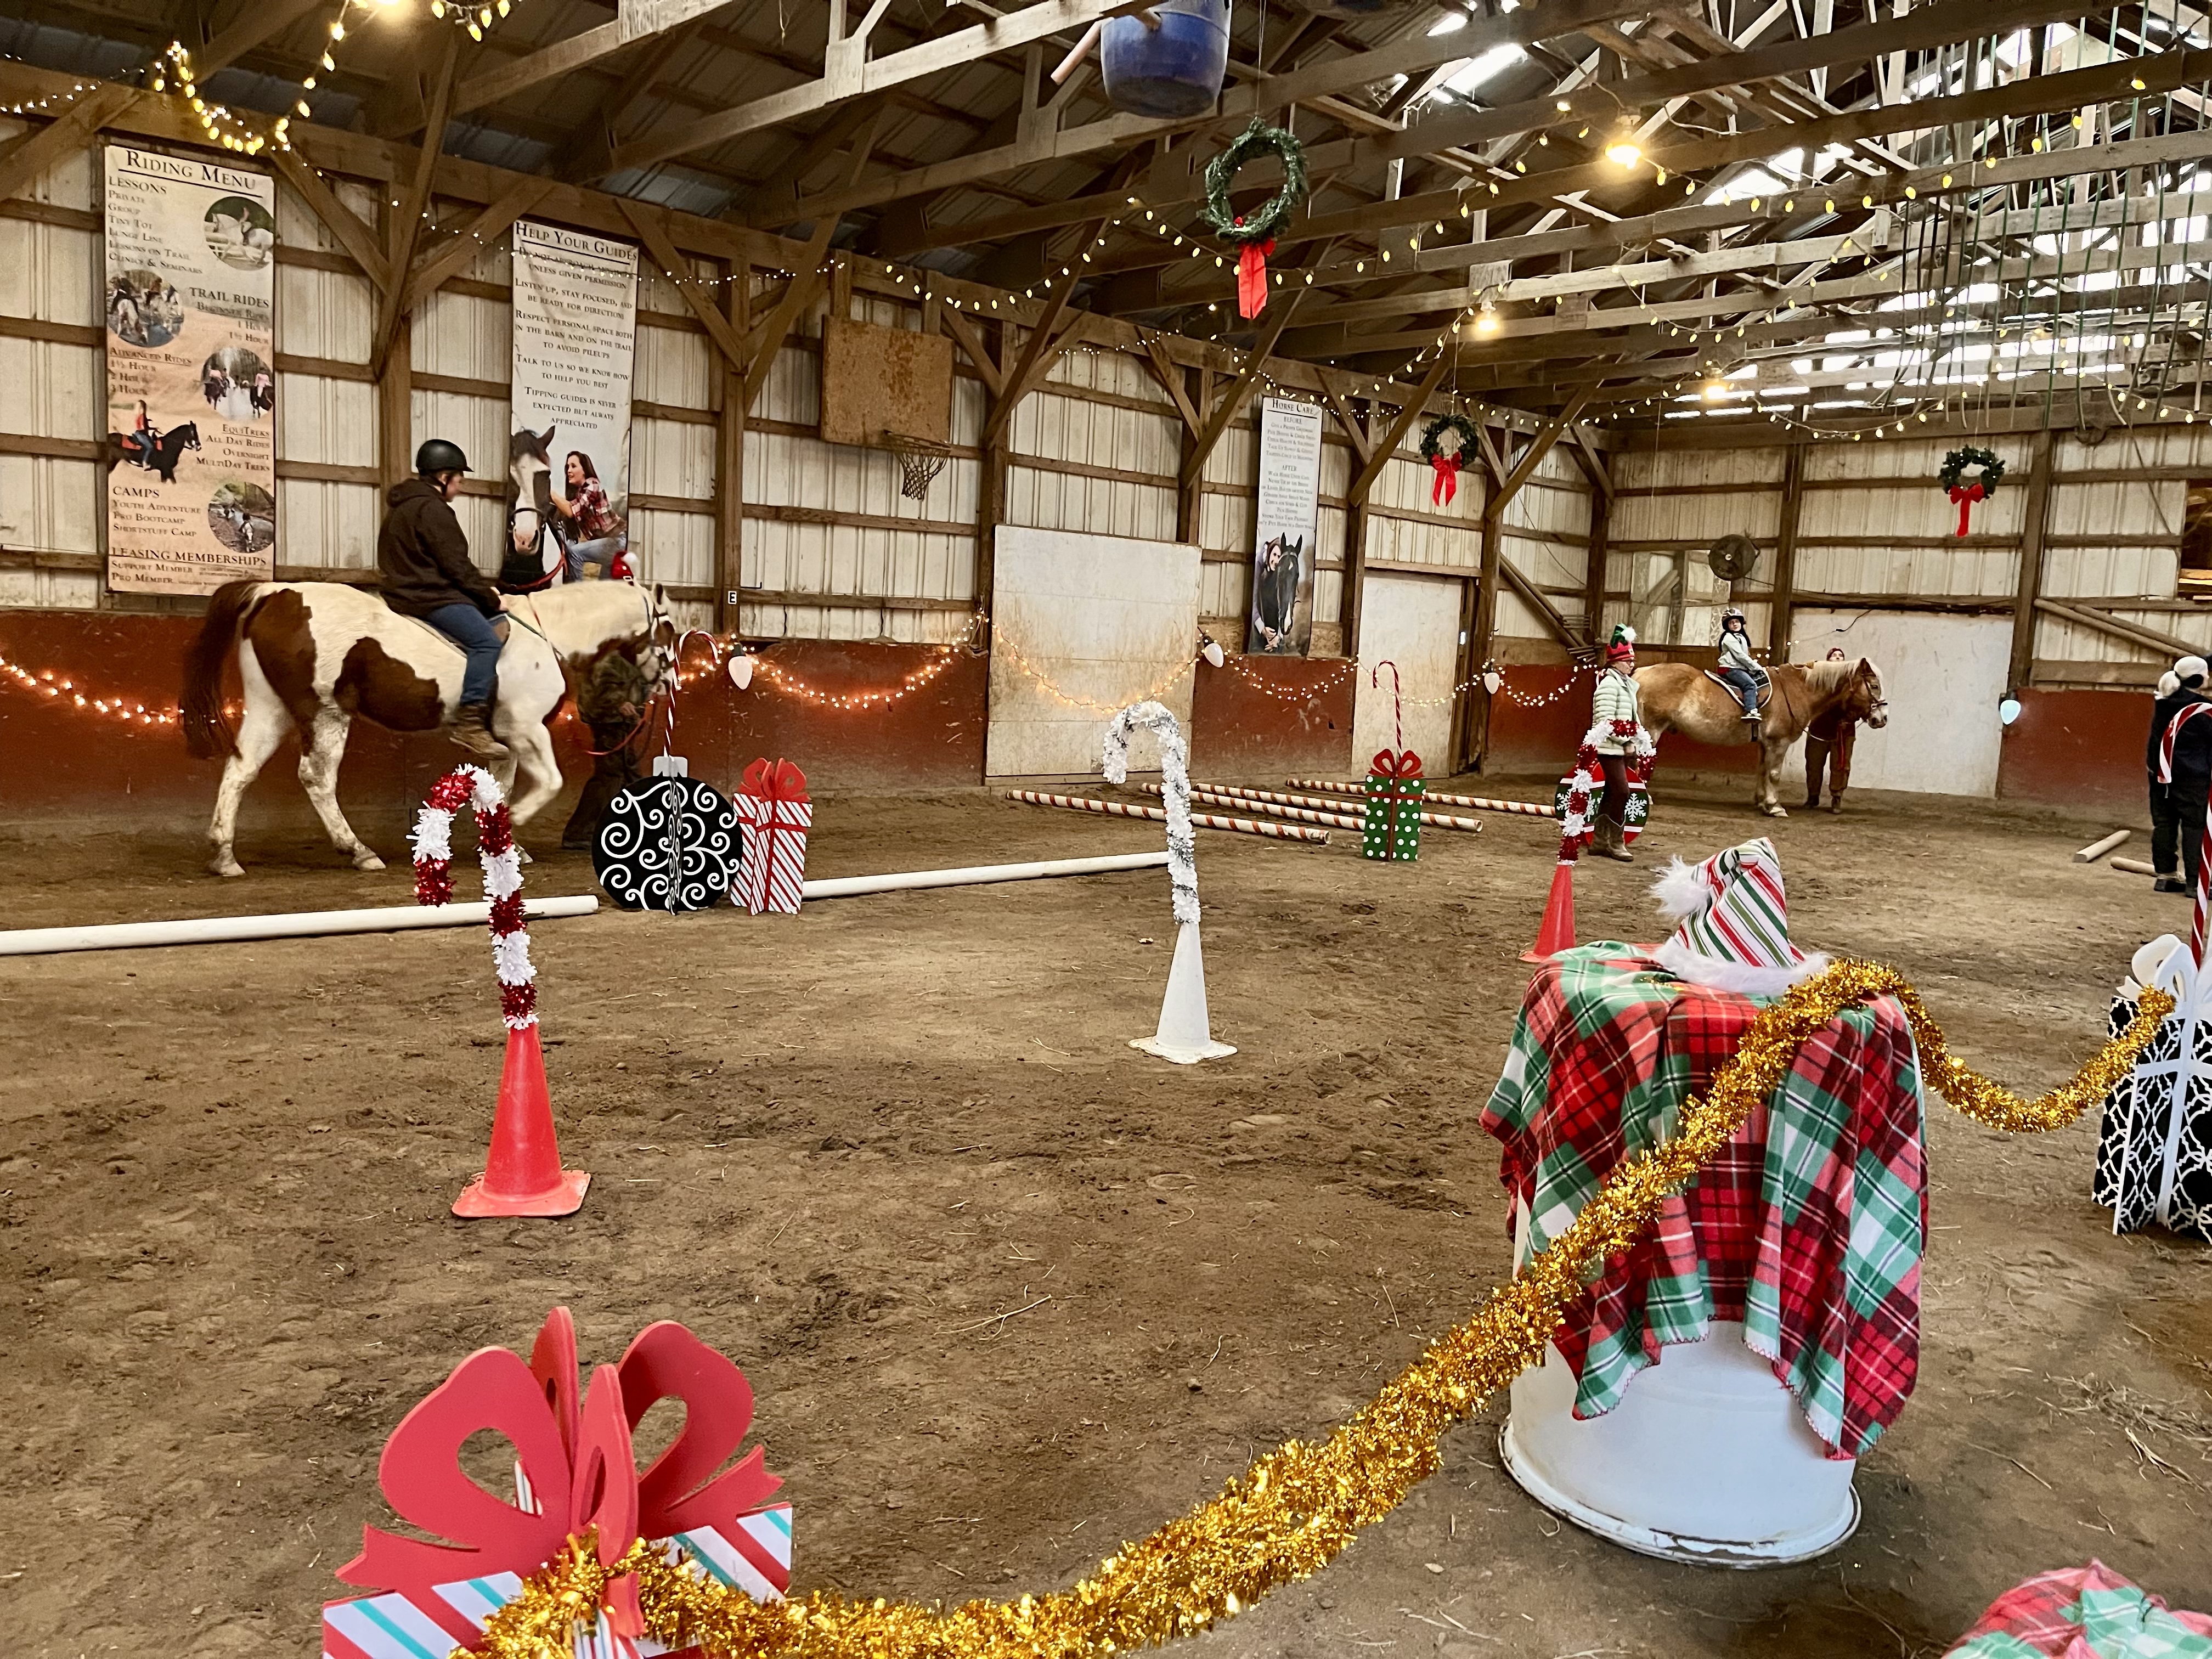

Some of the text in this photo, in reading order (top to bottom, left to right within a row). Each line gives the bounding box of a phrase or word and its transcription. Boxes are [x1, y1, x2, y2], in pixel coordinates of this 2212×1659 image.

[126, 150, 256, 190] RIDING MENU
[109, 176, 167, 194] LESSONS
[109, 190, 145, 204] PRIVATE
[108, 202, 140, 215] GROUP
[516, 222, 637, 261] HELP YOUR GUIDES
[165, 249, 191, 260] TRAIL
[147, 258, 156, 267] &
[529, 263, 626, 289] UNLESS GIVEN PERMISSION
[189, 287, 269, 308] TRAIL RIDES
[515, 278, 543, 290] LISTEN
[546, 286, 558, 295] UP,
[562, 290, 579, 298] STAY
[583, 294, 617, 307] FOCUSED,
[540, 297, 563, 307] READY
[516, 309, 632, 339] RESPECT PERSONAL SPACE BOTH
[246, 334, 268, 345] HOUR
[527, 326, 541, 334] THE
[545, 329, 565, 338] BARN
[614, 342, 632, 351] TRAIL
[110, 347, 191, 363] ADVANCED RIDES
[557, 344, 580, 353] AVOID
[583, 349, 610, 359] PILEUPS
[129, 362, 156, 371] HOUR
[517, 353, 538, 365] TALK
[592, 369, 611, 377] KNOW
[555, 374, 573, 382] HELP
[594, 381, 608, 389] BEST
[524, 386, 558, 398] TIPPING
[561, 394, 587, 403] GUIDES
[533, 402, 571, 413] EXPECTED
[591, 412, 614, 420] ALWAYS
[1273, 398, 1313, 414] HORSE CARE
[223, 424, 269, 436] EQUITREKS
[550, 417, 597, 430] APPRECIATED
[206, 435, 270, 448] ALL DAY RIDES
[223, 448, 269, 460] OVERNIGHT
[245, 462, 270, 471] TREKS
[112, 486, 160, 499] CAMPS
[112, 500, 201, 514] YOUTH ADVENTURE
[113, 511, 185, 524] PRO BOOTCAMP
[114, 523, 197, 537] SHORTSTUFF CAMP
[112, 547, 267, 566] LEASING MEMBERSHIPS
[111, 561, 152, 571] SUPPORT
[156, 564, 193, 573] MEMBER
[112, 572, 132, 582] PRO
[136, 574, 173, 583] MEMBER
[730, 592, 736, 603] E
